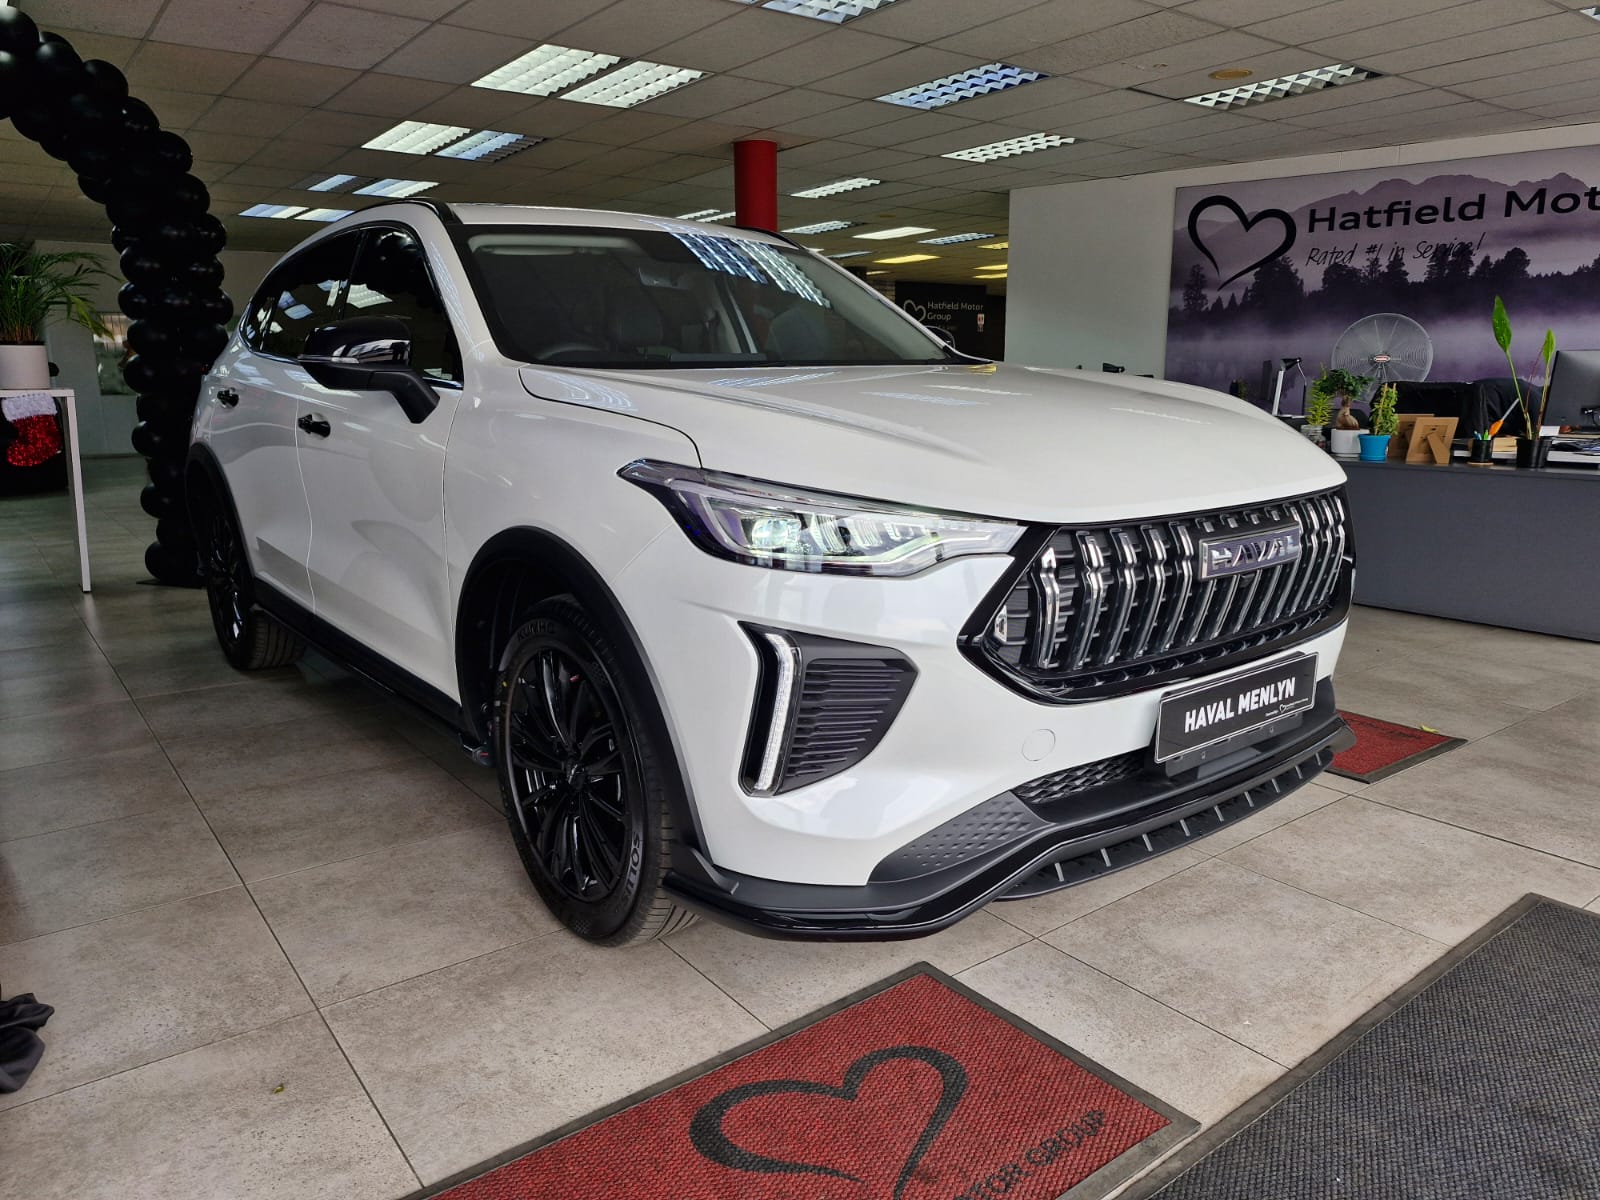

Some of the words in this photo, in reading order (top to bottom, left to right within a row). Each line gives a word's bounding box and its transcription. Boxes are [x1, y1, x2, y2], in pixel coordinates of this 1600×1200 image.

[1308, 193, 1486, 233] Hatfield
[1305, 242, 1358, 266] Rated
[1366, 243, 1384, 262] #1
[1389, 242, 1405, 261] in
[1413, 232, 1487, 260] Service!
[927, 301, 959, 310] Hatfield
[960, 302, 984, 311] Motor
[927, 312, 952, 321] Group
[1210, 535, 1299, 570] HAVAL
[1184, 698, 1235, 733] HAVAL
[1238, 677, 1296, 715] MENLYN
[953, 1162, 1033, 1200] TOR
[1024, 1109, 1105, 1167] GROUP
